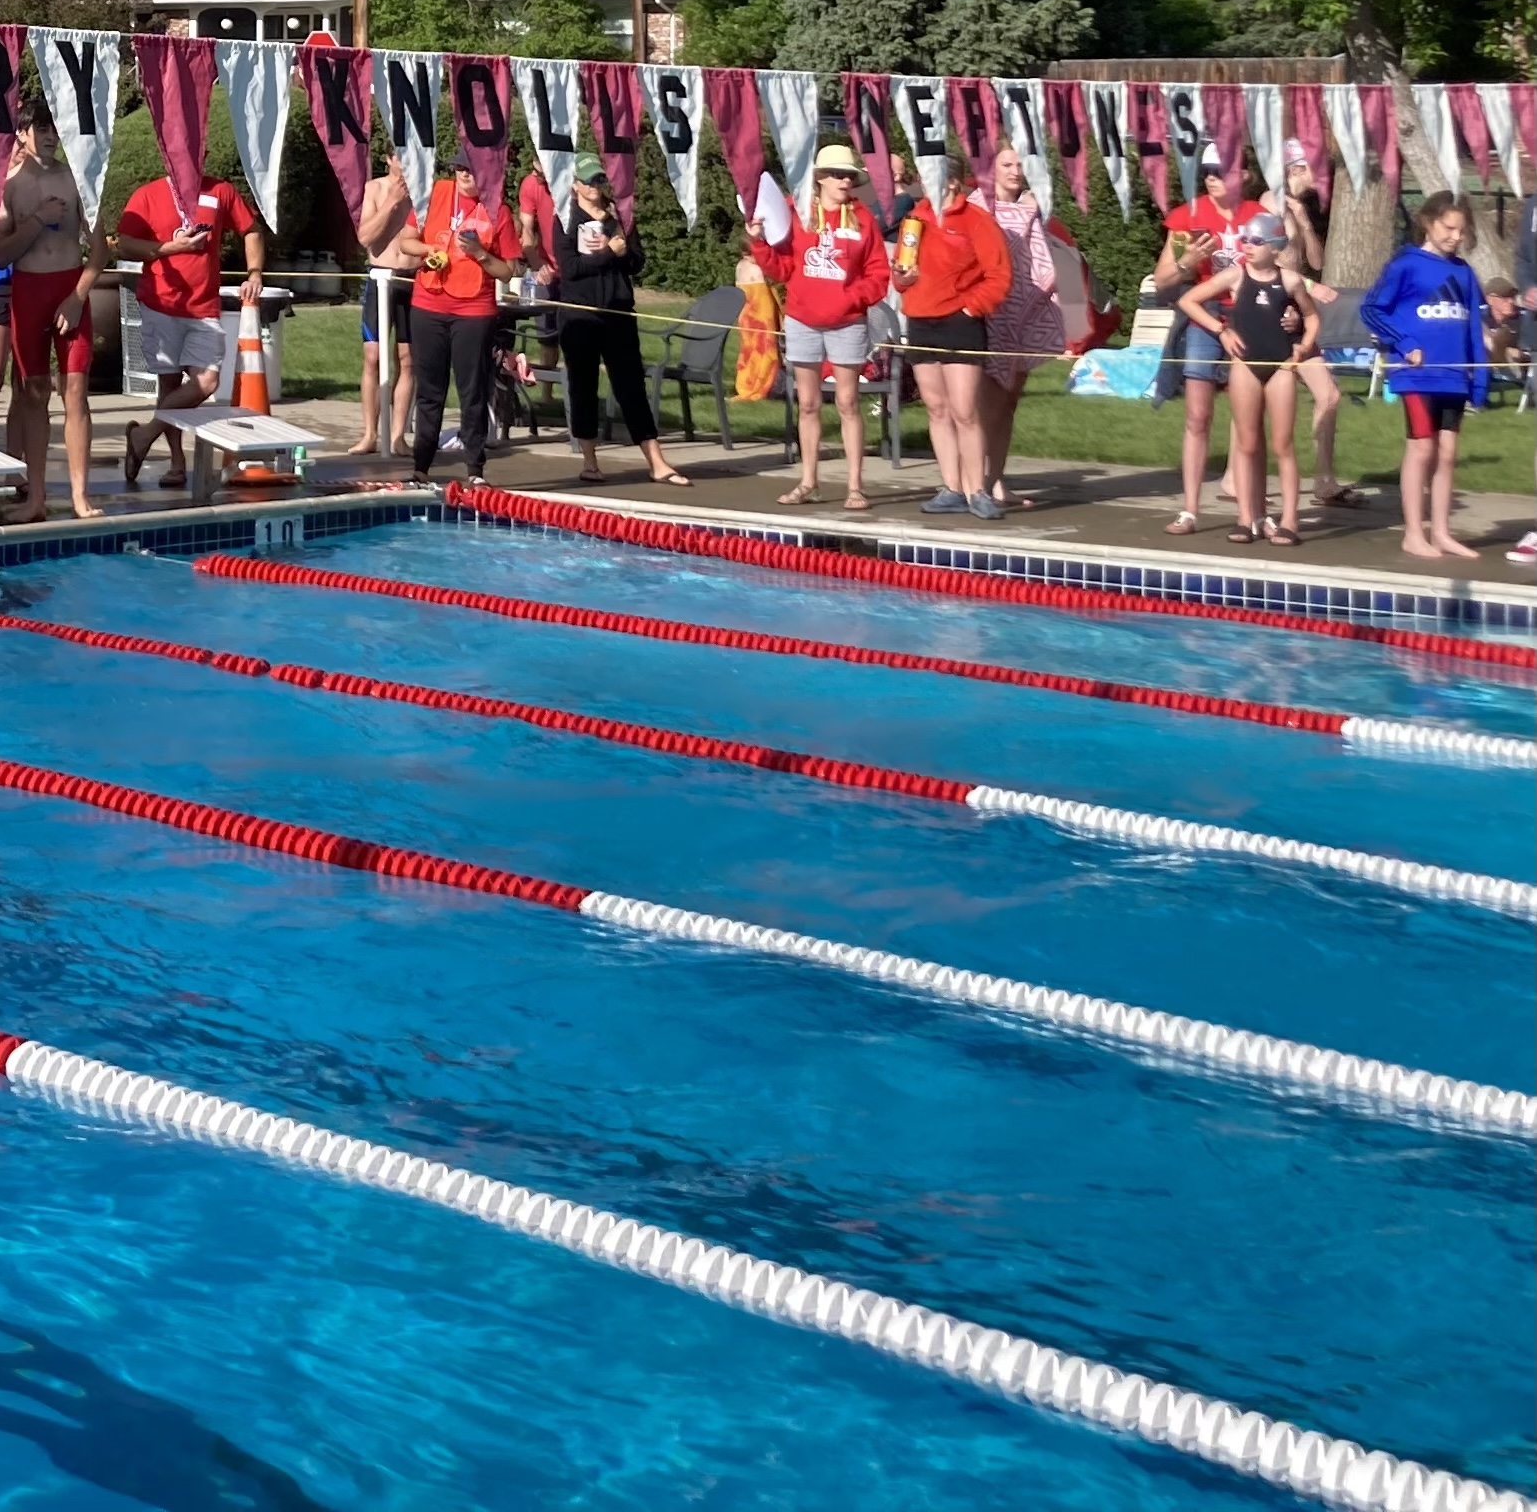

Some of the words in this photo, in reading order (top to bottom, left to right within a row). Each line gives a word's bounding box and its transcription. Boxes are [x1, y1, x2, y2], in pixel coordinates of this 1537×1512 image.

[315, 58, 693, 154] KNOLLS
[856, 85, 1199, 158] NEPTUNES
[1416, 301, 1470, 320] adid
[265, 519, 295, 546] 10
